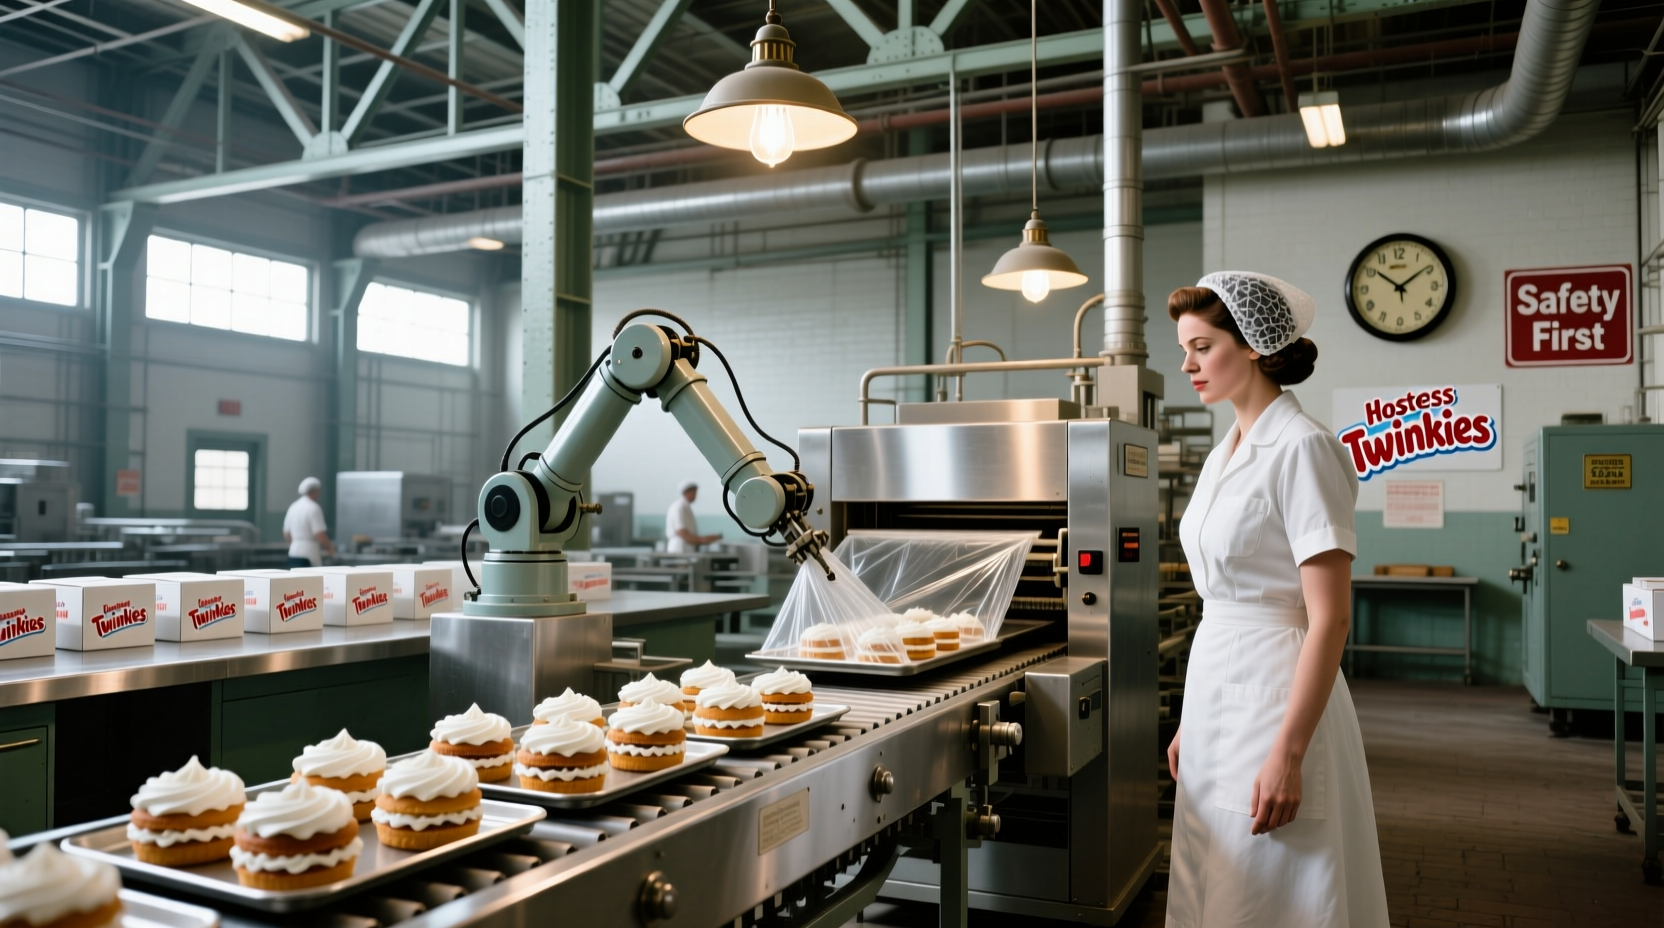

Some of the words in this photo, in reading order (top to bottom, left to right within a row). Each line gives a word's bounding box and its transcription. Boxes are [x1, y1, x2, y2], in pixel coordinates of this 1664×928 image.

[1394, 247, 1405, 260] 12
[1517, 282, 1620, 321] Safety
[1532, 321, 1605, 351] First
[1365, 387, 1454, 426] Hostess
[1341, 409, 1491, 473] Twinkies
[0, 615, 45, 643] inkies
